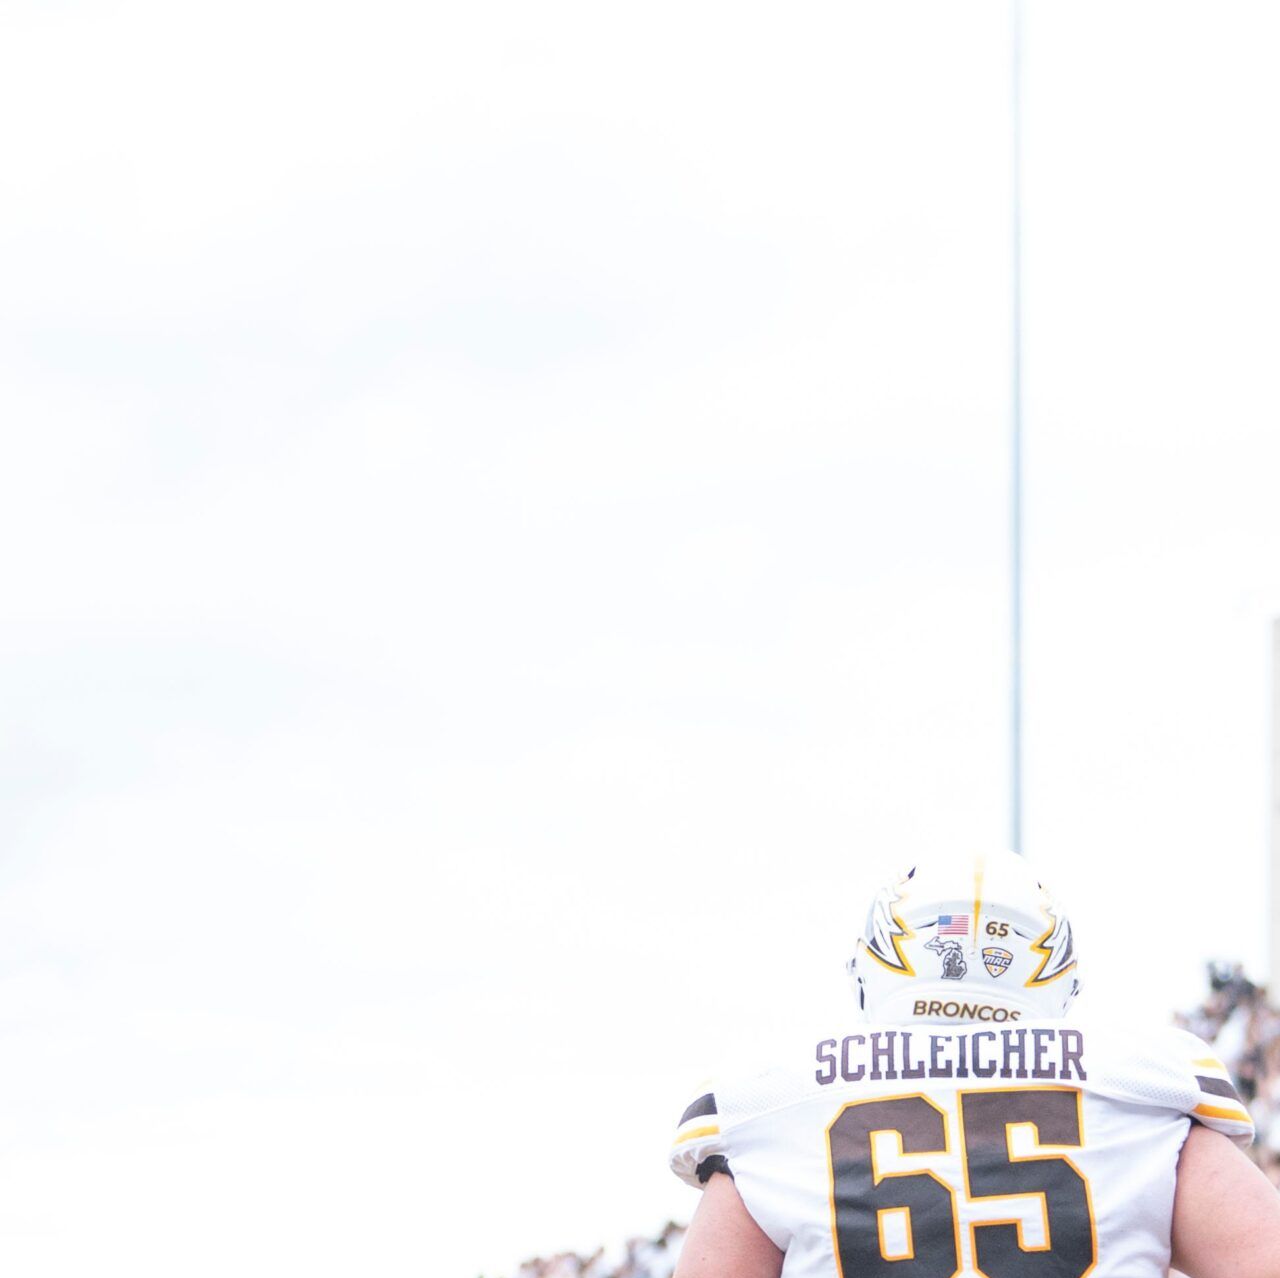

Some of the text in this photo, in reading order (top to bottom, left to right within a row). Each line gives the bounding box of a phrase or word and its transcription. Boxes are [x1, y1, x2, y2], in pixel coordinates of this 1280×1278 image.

[985, 921, 1010, 937] 65
[912, 1000, 1021, 1022] BRONCOS
[815, 1028, 1088, 1086] SCHLEICHER
